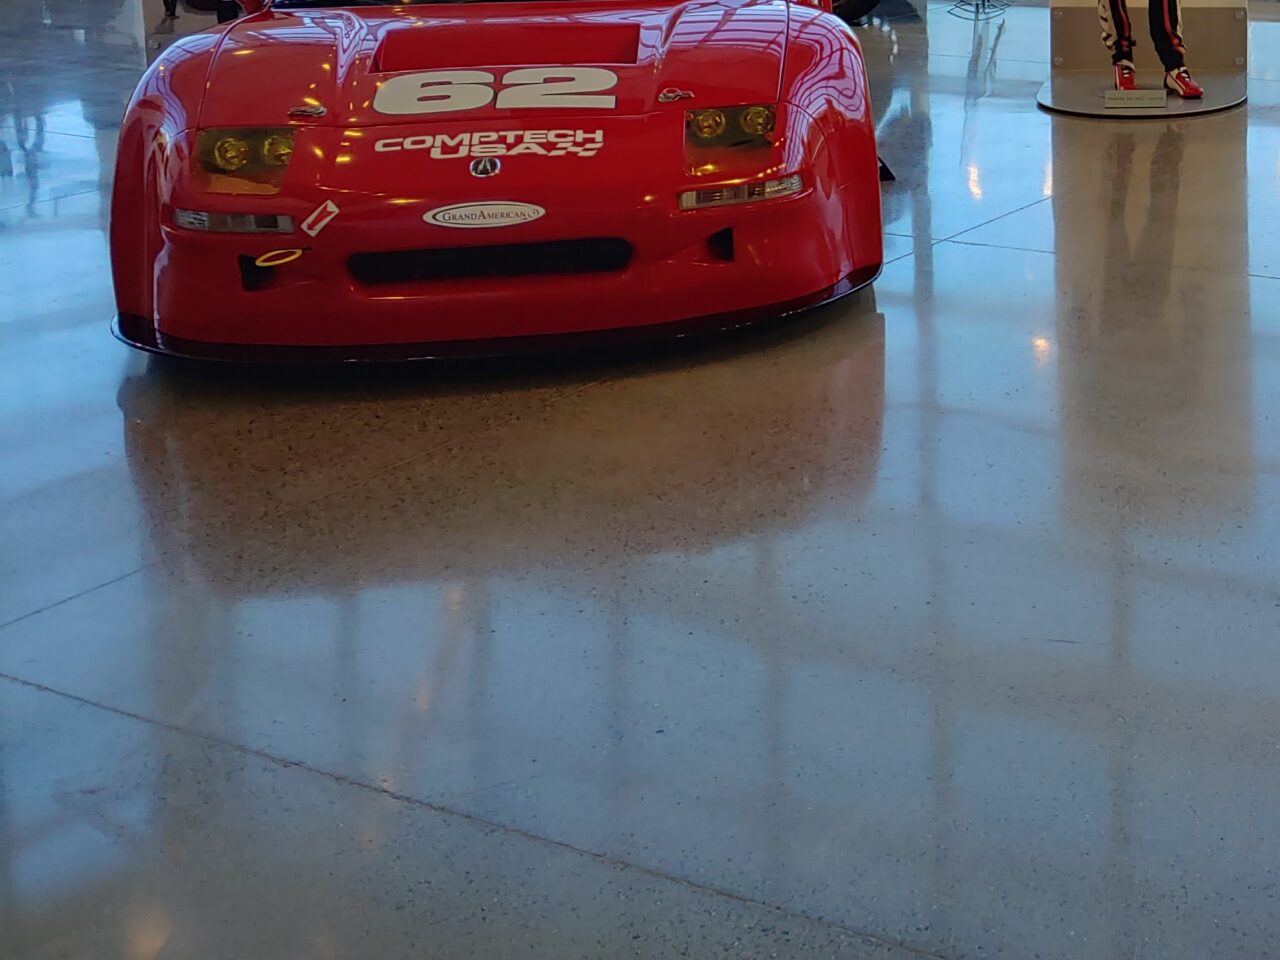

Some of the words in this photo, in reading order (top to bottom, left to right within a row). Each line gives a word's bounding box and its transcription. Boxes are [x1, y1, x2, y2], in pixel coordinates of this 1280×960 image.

[372, 67, 618, 115] 62
[374, 129, 604, 152] COMPTECH
[430, 142, 549, 159] USA
